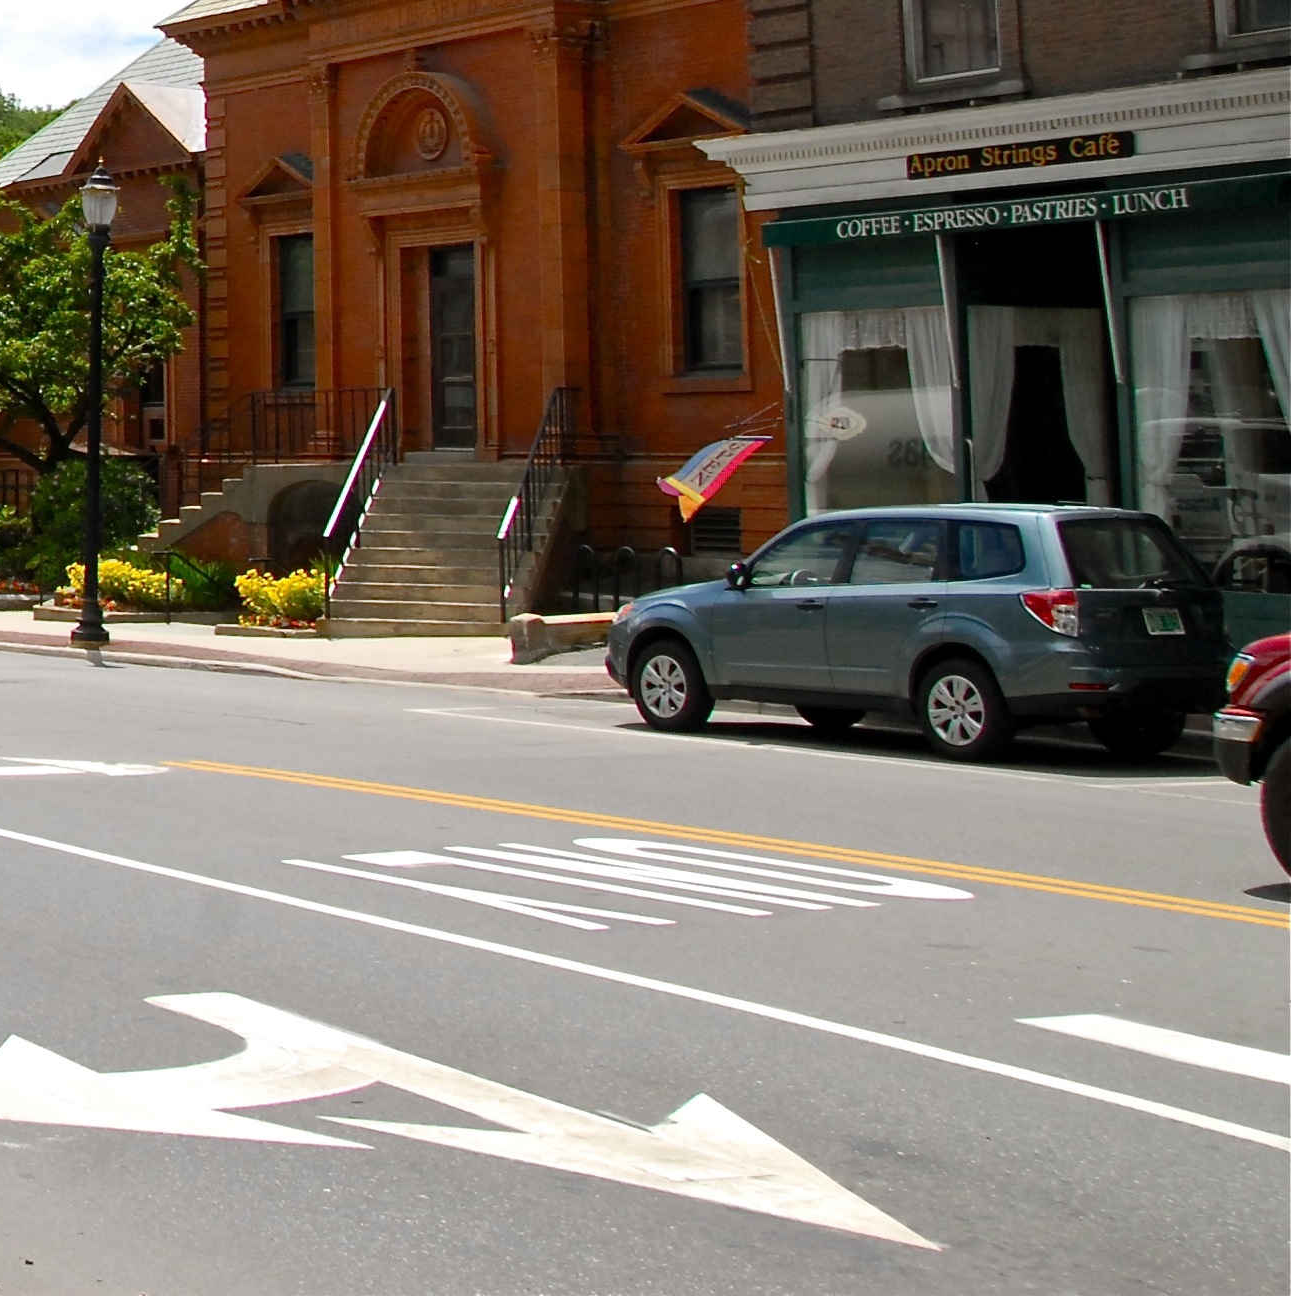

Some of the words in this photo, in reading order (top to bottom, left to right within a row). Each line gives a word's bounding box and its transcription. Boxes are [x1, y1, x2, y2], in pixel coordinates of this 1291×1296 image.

[909, 151, 972, 178] Apron
[980, 141, 1057, 168] Strings
[1069, 132, 1120, 159] Café
[836, 214, 901, 239] COFFEE
[913, 206, 1000, 232] ESPRESSO
[1010, 197, 1098, 225] PASTRIES
[1112, 187, 1189, 215] LUNCH
